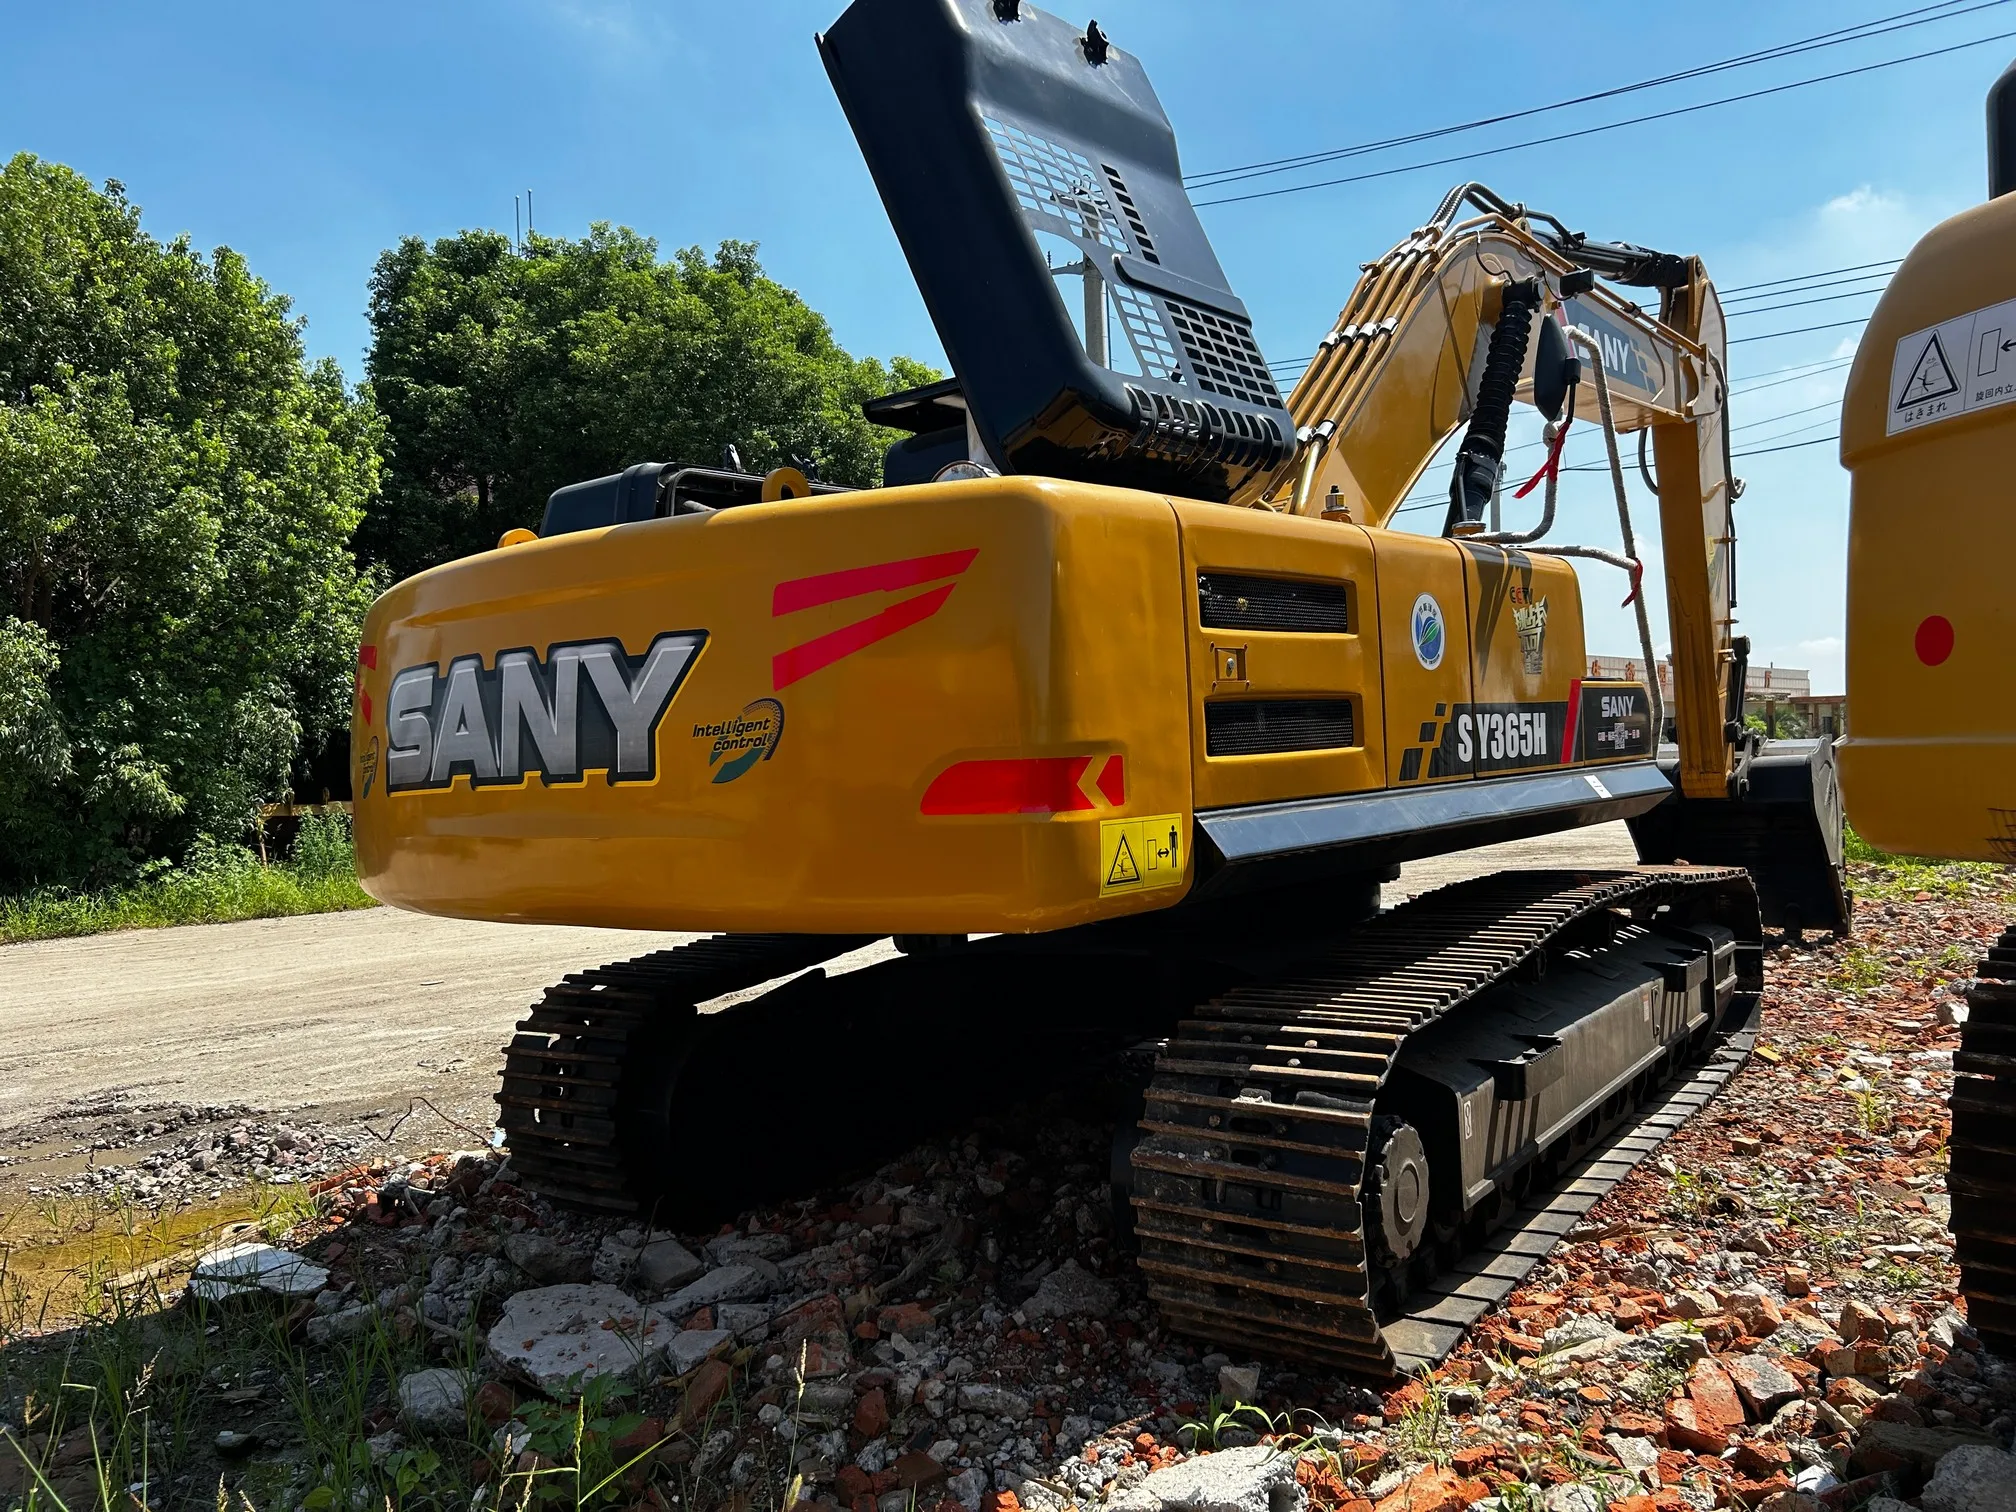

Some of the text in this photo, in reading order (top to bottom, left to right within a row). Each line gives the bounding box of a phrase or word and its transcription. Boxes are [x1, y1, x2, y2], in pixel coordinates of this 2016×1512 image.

[1975, 383, 2016, 402] 旋回内立
[387, 630, 709, 793] SANY
[1601, 695, 1635, 718] SANY
[692, 717, 771, 738] Intelligent
[1458, 712, 1547, 763] SY365H
[713, 733, 768, 751] control
